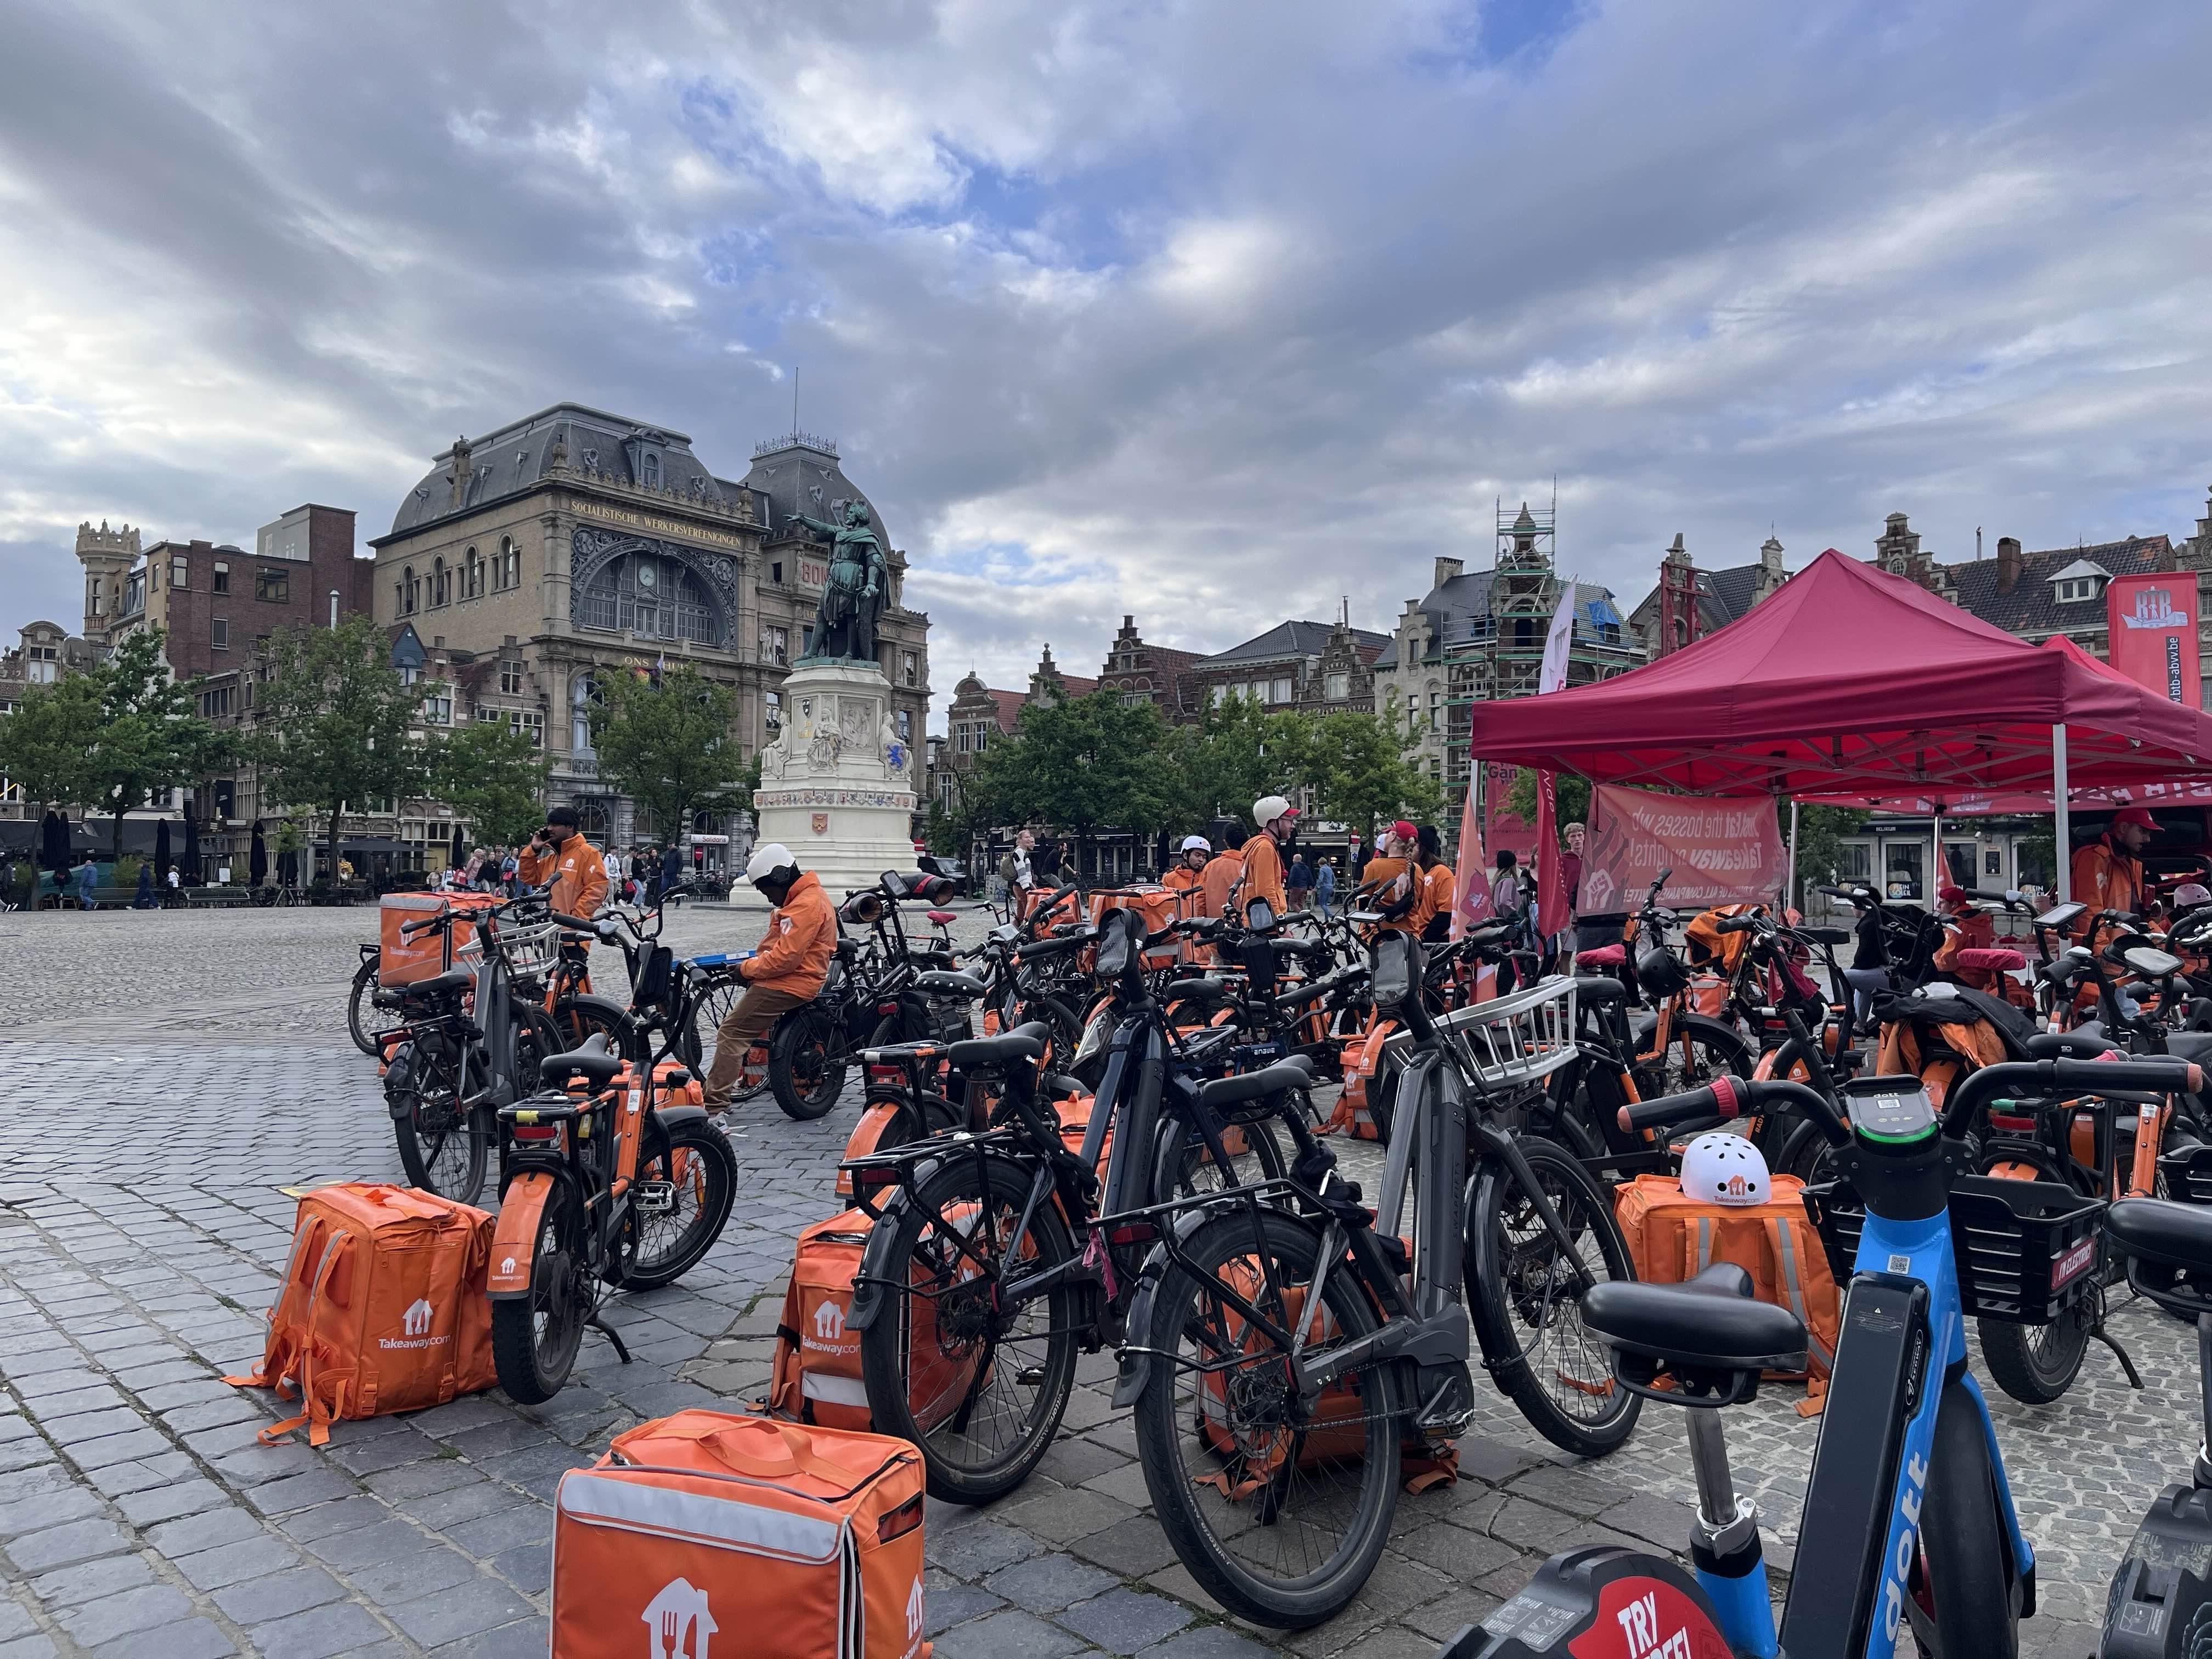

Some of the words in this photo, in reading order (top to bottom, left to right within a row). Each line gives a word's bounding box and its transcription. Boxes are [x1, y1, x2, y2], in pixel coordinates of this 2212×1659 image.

[572, 501, 639, 524] SOCIALISTISCHE
[644, 517, 741, 546] WERKERSVEREENIGINGEN
[624, 656, 649, 667] ONS
[1755, 1118, 1764, 1133] RAD
[1714, 1196, 1760, 1204] Takeaway.com
[378, 1334, 451, 1349] Takeaway.com
[1886, 1451, 1928, 1642] dott
[1617, 1591, 1657, 1659] TRY
